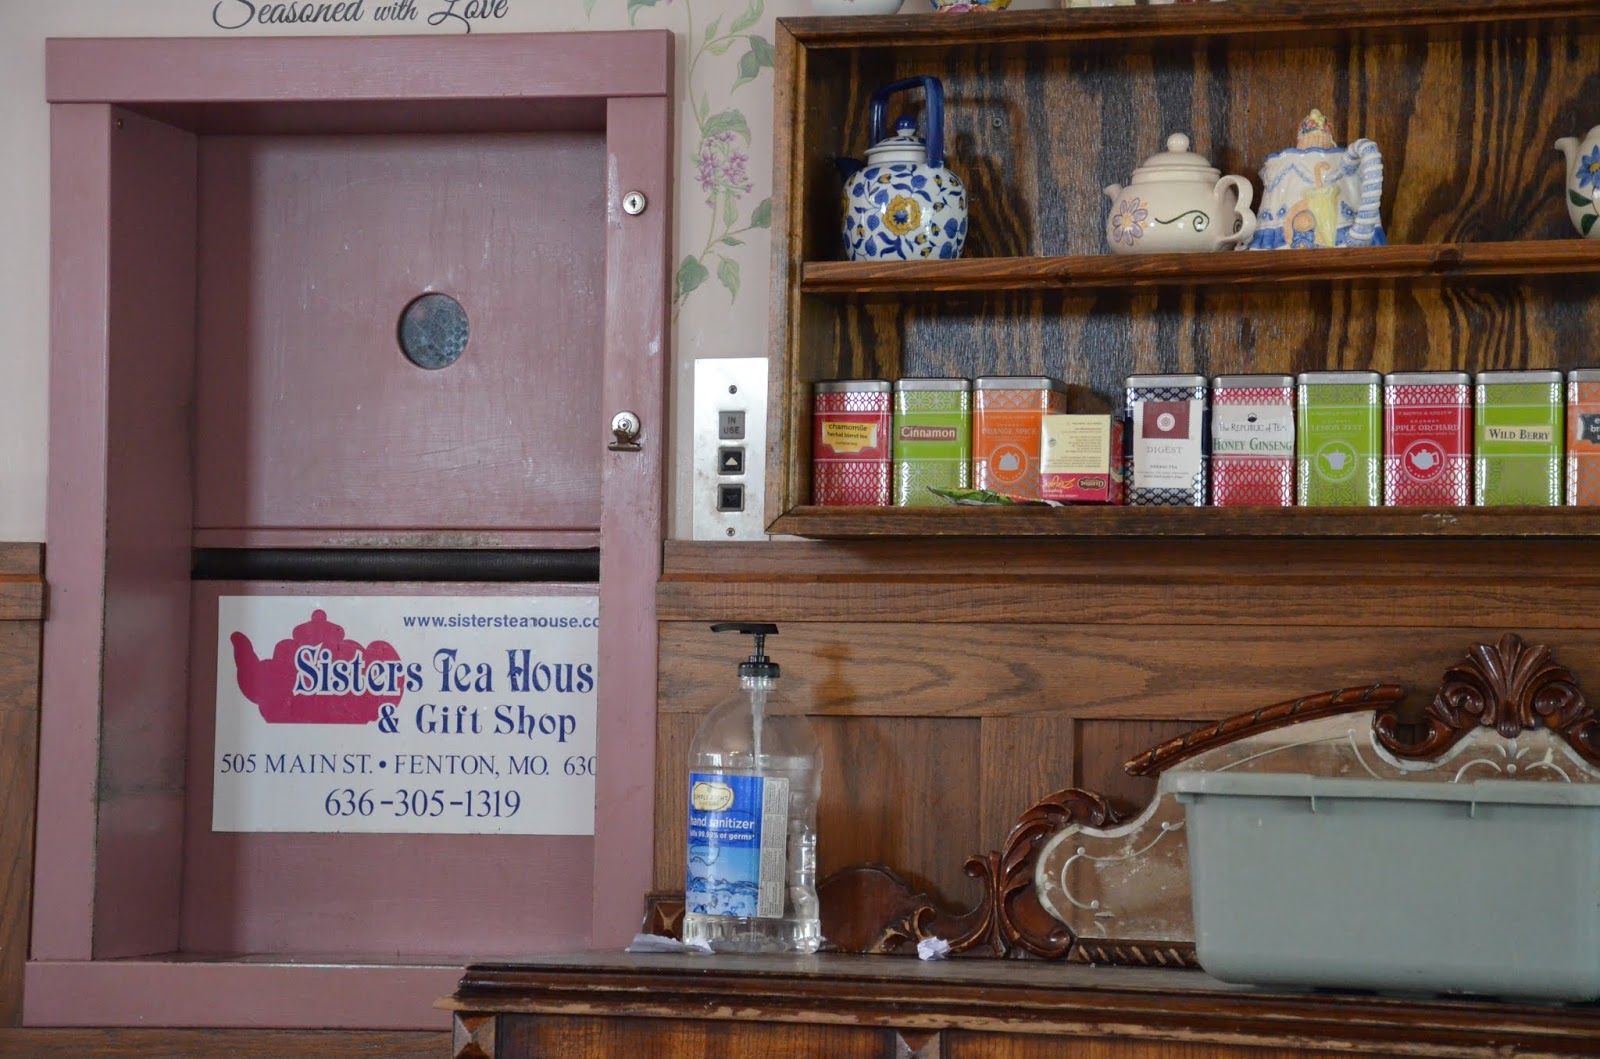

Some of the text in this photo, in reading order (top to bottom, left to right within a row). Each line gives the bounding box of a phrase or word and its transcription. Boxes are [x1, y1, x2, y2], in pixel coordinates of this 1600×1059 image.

[212, 0, 509, 34] Seasoned with Love
[728, 416, 736, 424] IN
[723, 426, 740, 434] USE
[828, 423, 867, 432] chamomile
[901, 426, 956, 439] Cinnamon
[1489, 428, 1550, 440] WILD BERRY
[1146, 446, 1183, 454] DIGEST
[1213, 438, 1292, 450] HONEY GINSENG
[295, 646, 423, 692] Sisters
[433, 648, 494, 693] Tea
[377, 704, 576, 742] & Gift Shop
[221, 755, 257, 773] 505
[264, 755, 336, 773] MAIN
[342, 755, 373, 774] ST.
[395, 756, 499, 779] FENTON,
[509, 757, 549, 776] MO.
[325, 789, 521, 818] 636-305-1319
[709, 818, 754, 829] sanitizer
